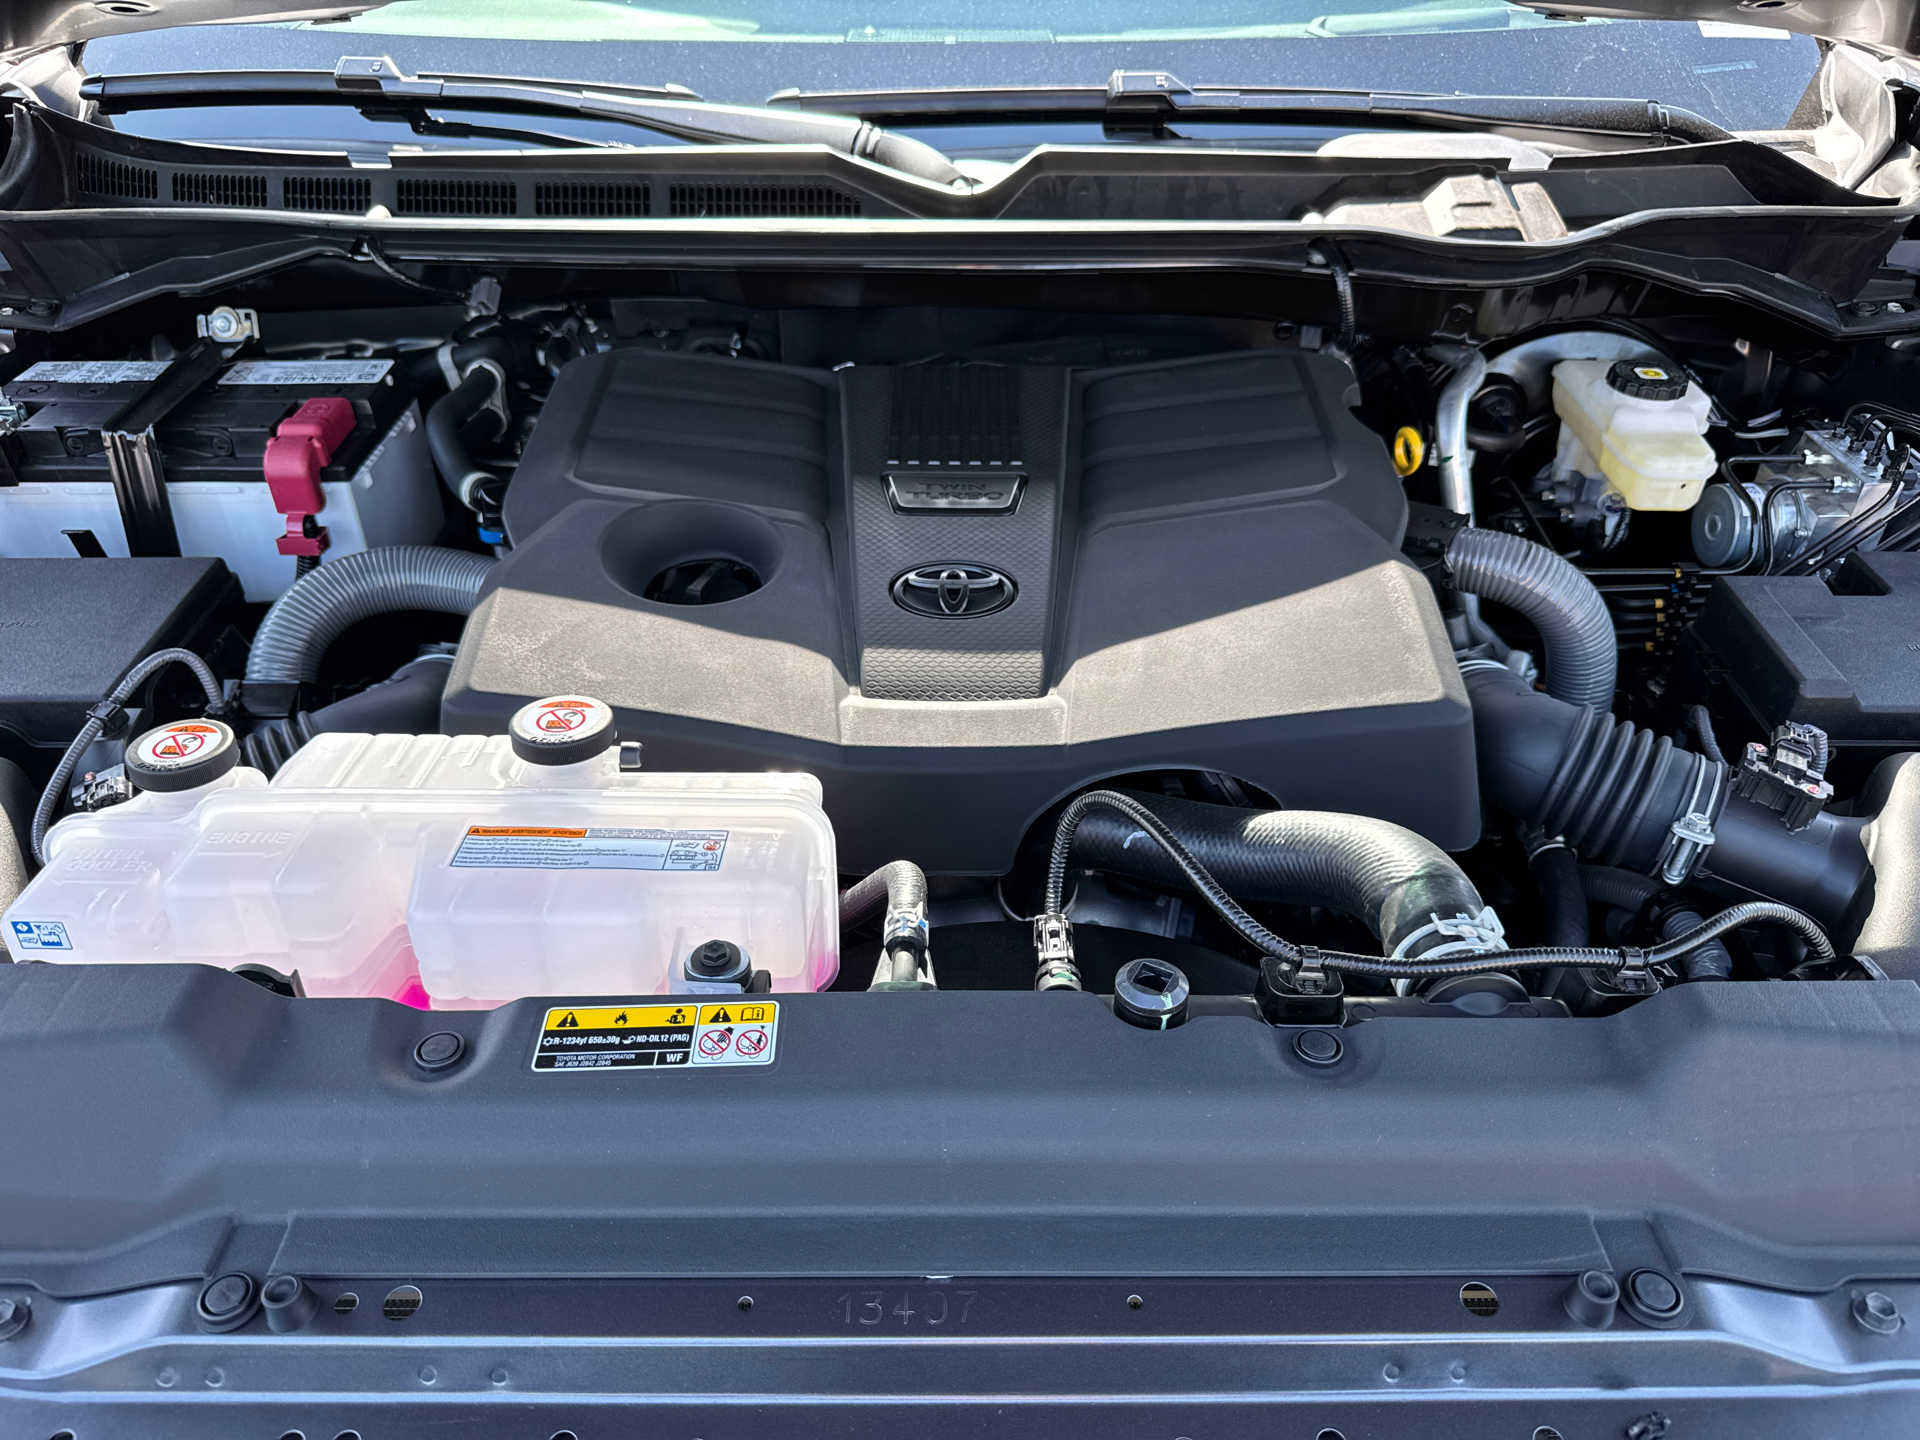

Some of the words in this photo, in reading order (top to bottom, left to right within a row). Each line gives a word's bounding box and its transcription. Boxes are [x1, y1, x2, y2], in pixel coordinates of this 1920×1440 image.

[919, 482, 986, 490] TWIN
[906, 491, 1003, 500] TURBO
[207, 831, 291, 844] ENGINE
[74, 847, 144, 860] INTER
[66, 860, 152, 872] COOLER
[669, 1033, 690, 1043] (PAG)
[597, 1053, 636, 1061] CORPORATION
[666, 1054, 684, 1063] WF
[837, 1290, 980, 1326] 13407
